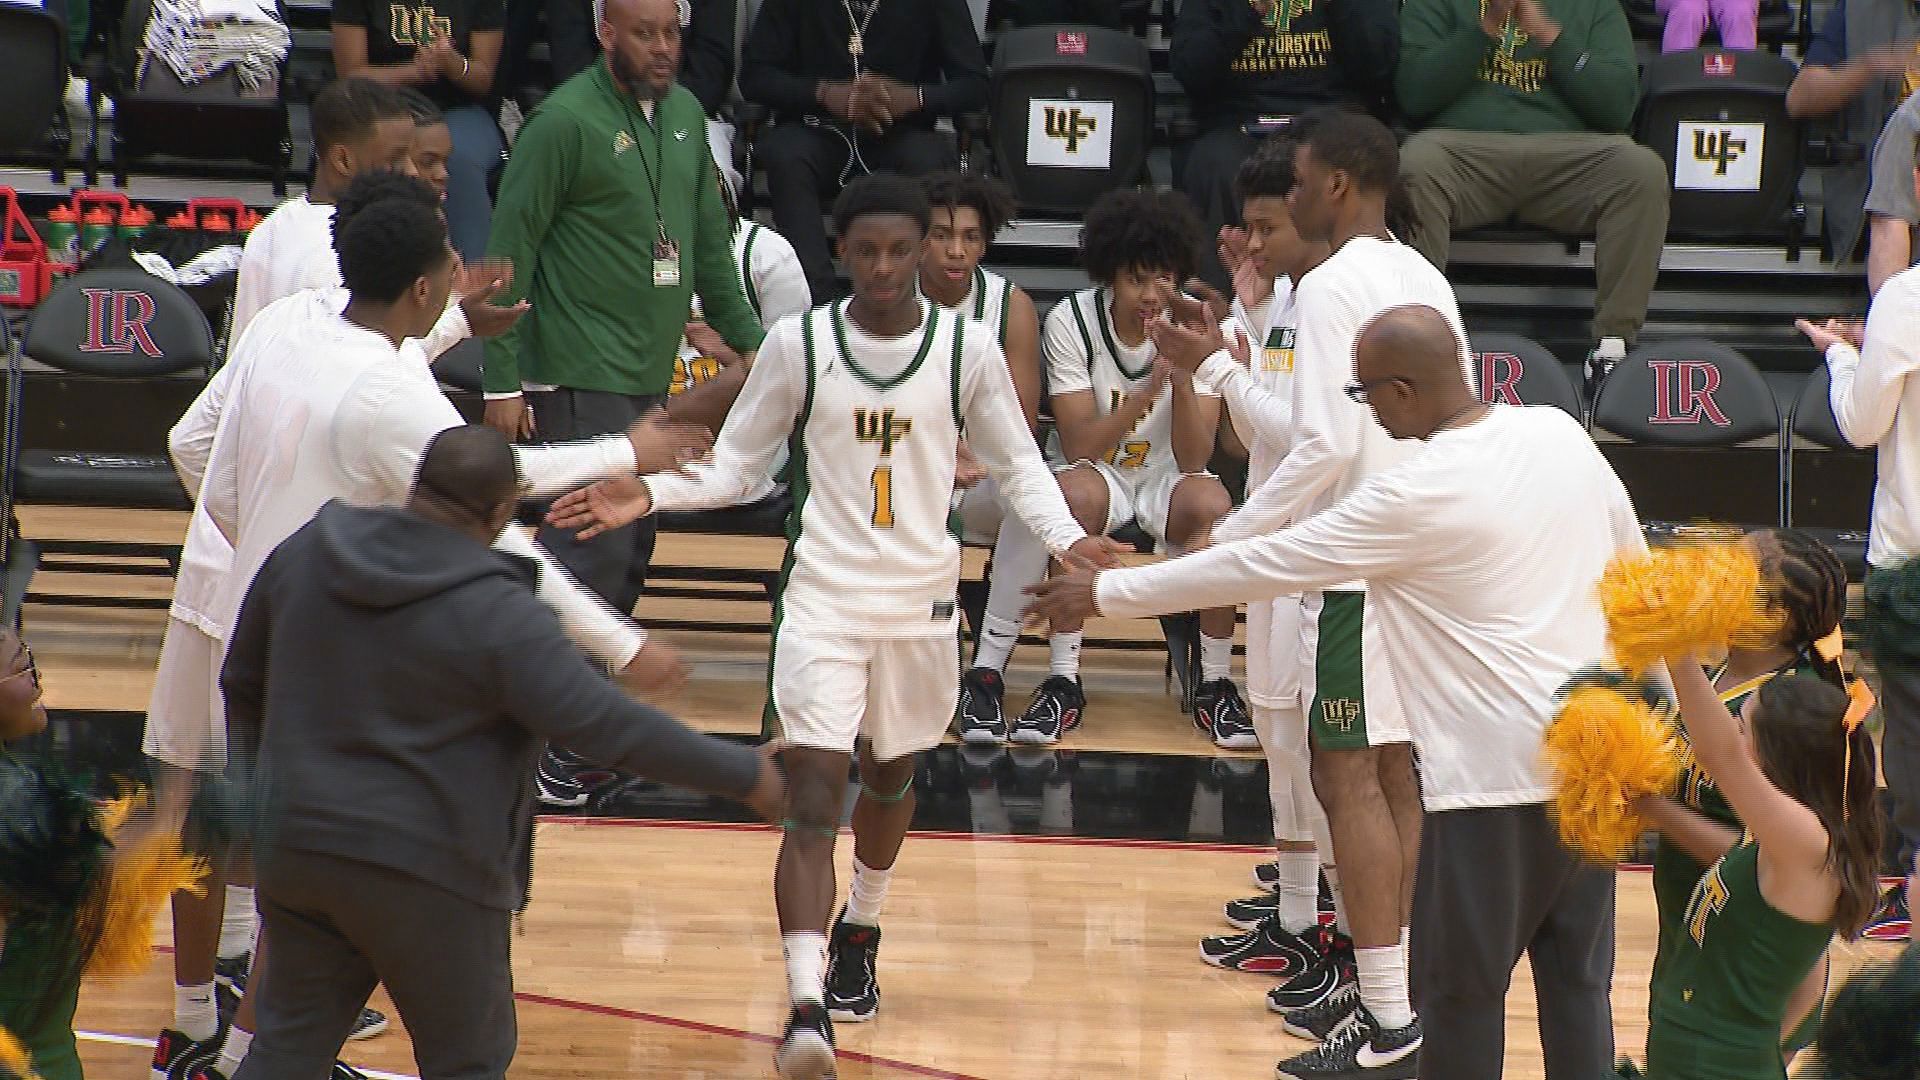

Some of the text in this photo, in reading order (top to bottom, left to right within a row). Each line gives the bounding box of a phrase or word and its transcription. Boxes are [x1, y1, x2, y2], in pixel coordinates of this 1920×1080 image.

[1267, 28, 1332, 55] FORSYTH
[1043, 106, 1097, 154] WF
[1692, 128, 1747, 176] WF
[79, 288, 164, 357] LR
[1475, 352, 1524, 406] R
[1648, 360, 1731, 426] LR
[853, 406, 912, 458] WF
[870, 465, 895, 529] 1
[1320, 697, 1360, 732] WF
